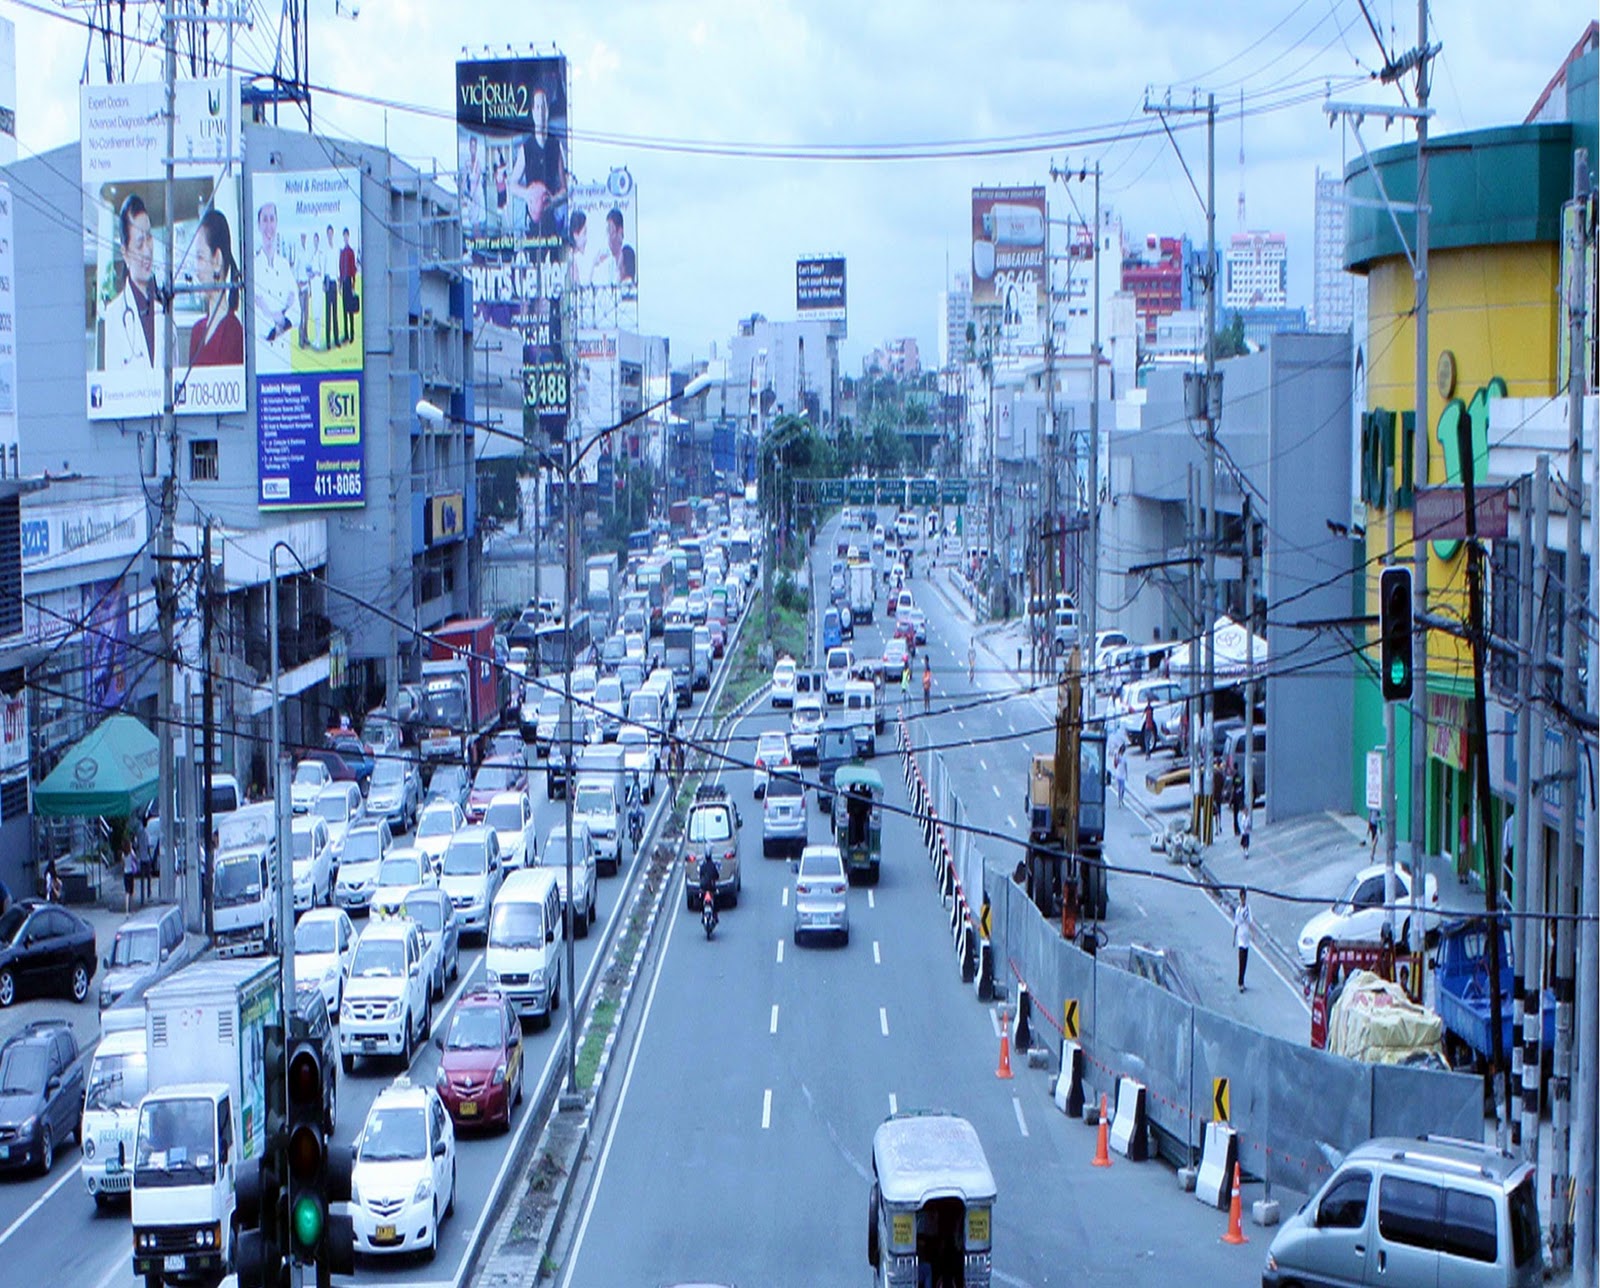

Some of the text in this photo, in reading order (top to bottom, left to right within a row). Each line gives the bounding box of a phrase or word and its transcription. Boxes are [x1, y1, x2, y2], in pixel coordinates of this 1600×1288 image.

[461, 76, 529, 123] VICTORIA 2
[285, 178, 303, 194] Hotel
[296, 200, 341, 216] Management
[995, 251, 1044, 268] UNBEATABLE
[189, 381, 240, 406] 708-0000
[334, 393, 355, 418] STI
[315, 473, 361, 496] 411-8065
